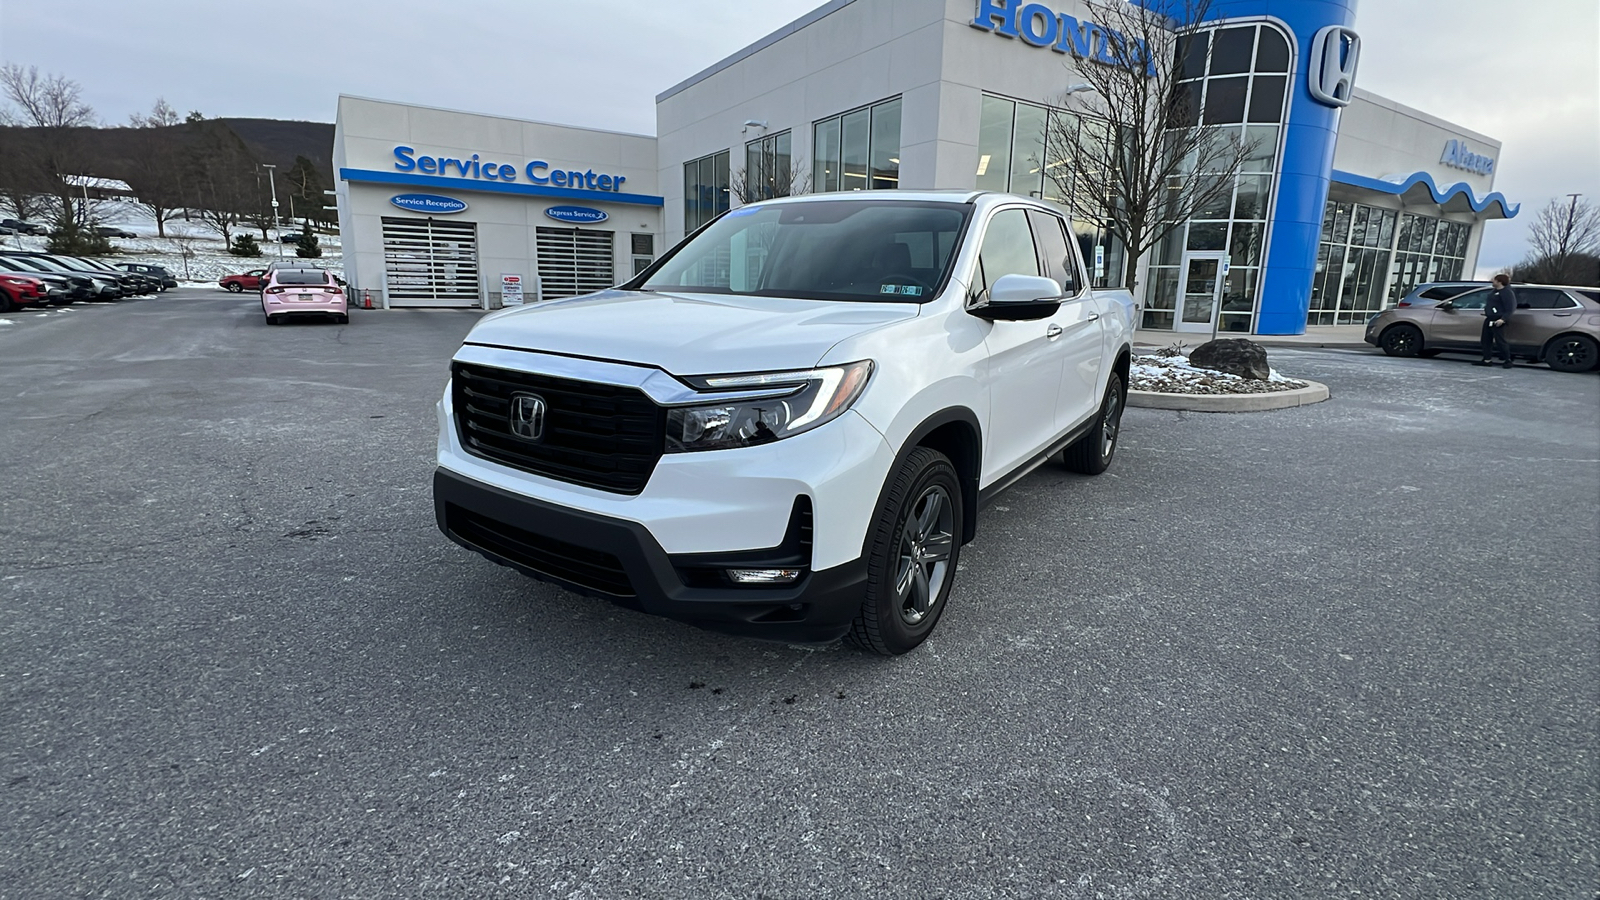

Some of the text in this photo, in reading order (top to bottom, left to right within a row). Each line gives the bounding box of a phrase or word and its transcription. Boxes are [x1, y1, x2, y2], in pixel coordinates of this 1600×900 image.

[393, 146, 626, 192] Service Center
[395, 197, 463, 208] Service Reception
